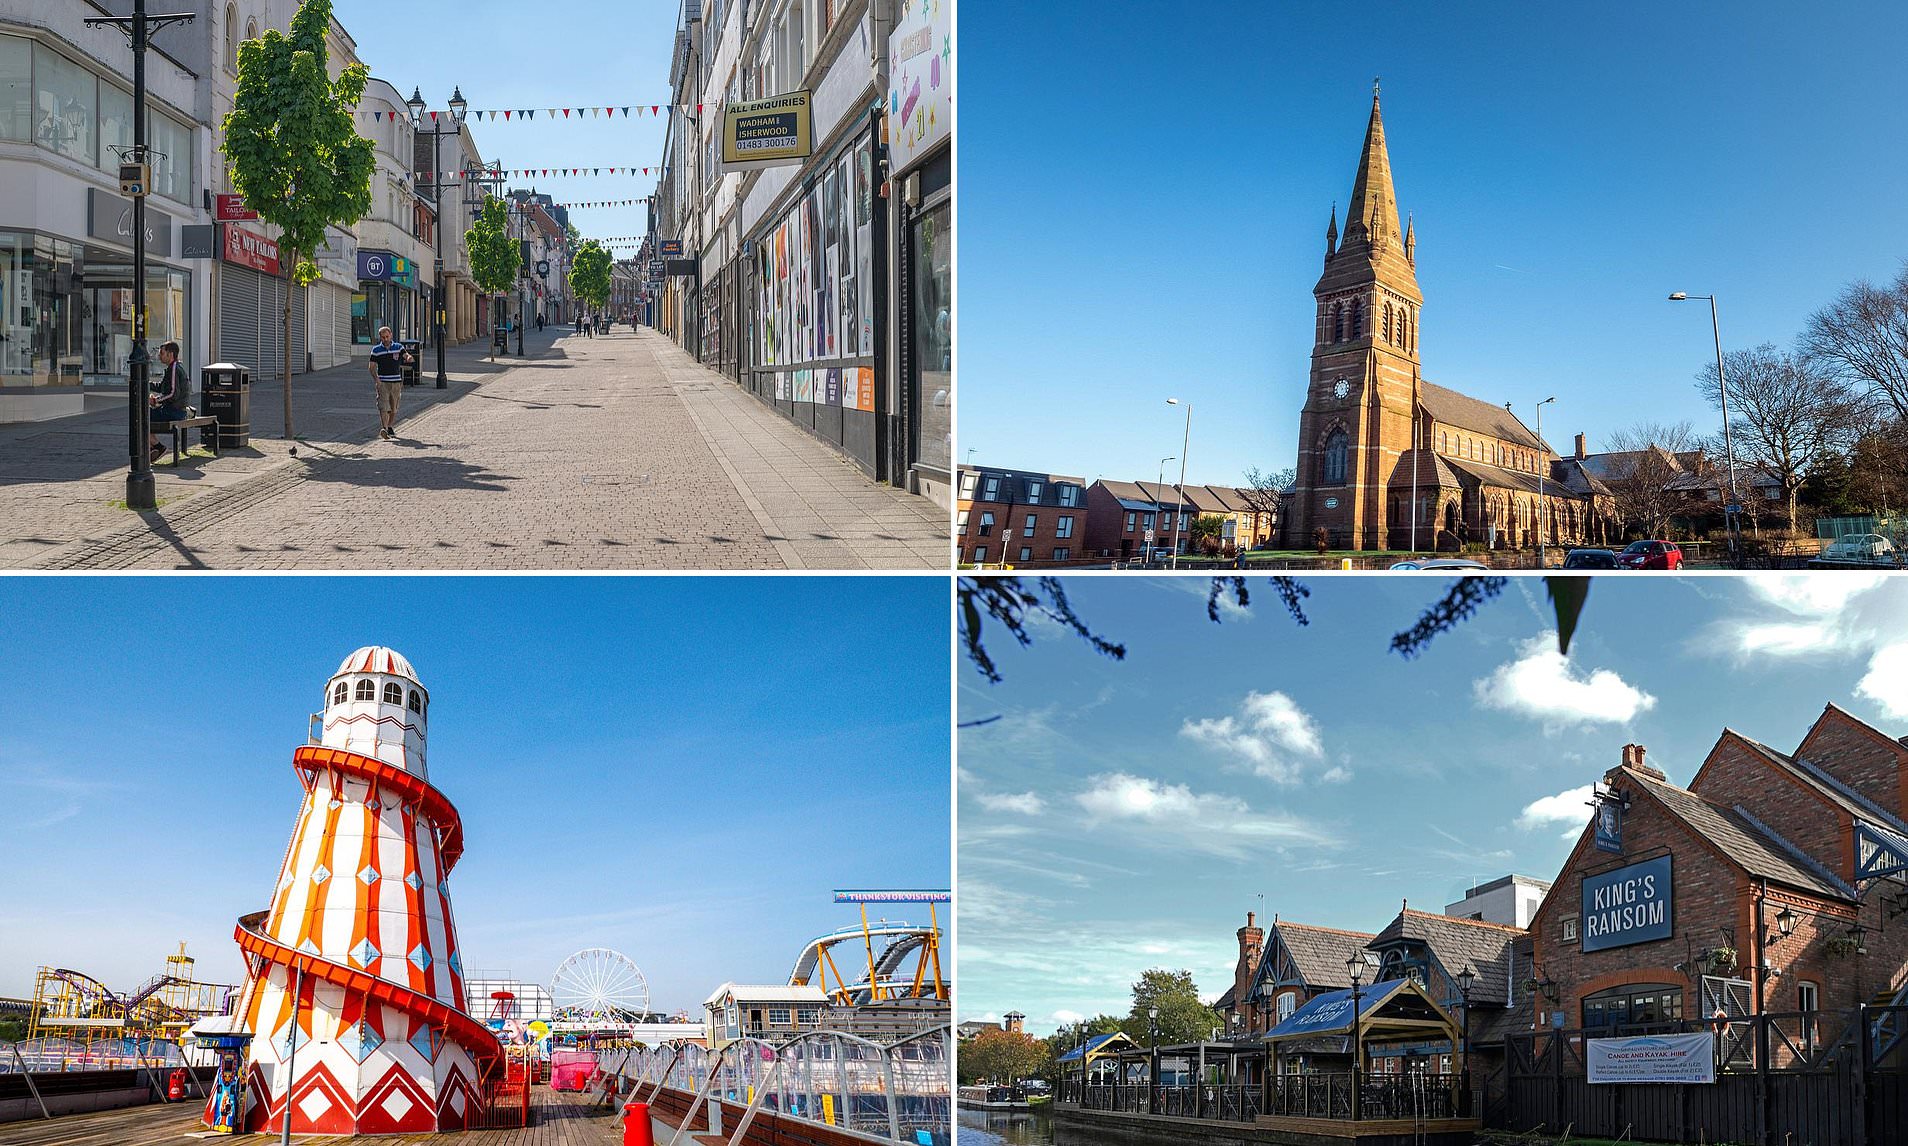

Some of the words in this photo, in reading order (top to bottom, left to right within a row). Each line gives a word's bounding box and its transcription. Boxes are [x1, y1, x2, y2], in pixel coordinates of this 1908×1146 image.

[729, 106, 748, 114] ALL
[750, 97, 806, 111] ENQUIRIES
[739, 117, 775, 127] WADHAM
[739, 127, 788, 138] ISHERWOOD
[737, 141, 762, 150] 01483
[764, 138, 796, 148] 300176
[117, 208, 153, 243] Clks
[370, 262, 380, 270] BT
[905, 893, 947, 901] VISITING
[1594, 875, 1655, 911] KING'S
[1587, 900, 1664, 938] RANSOM
